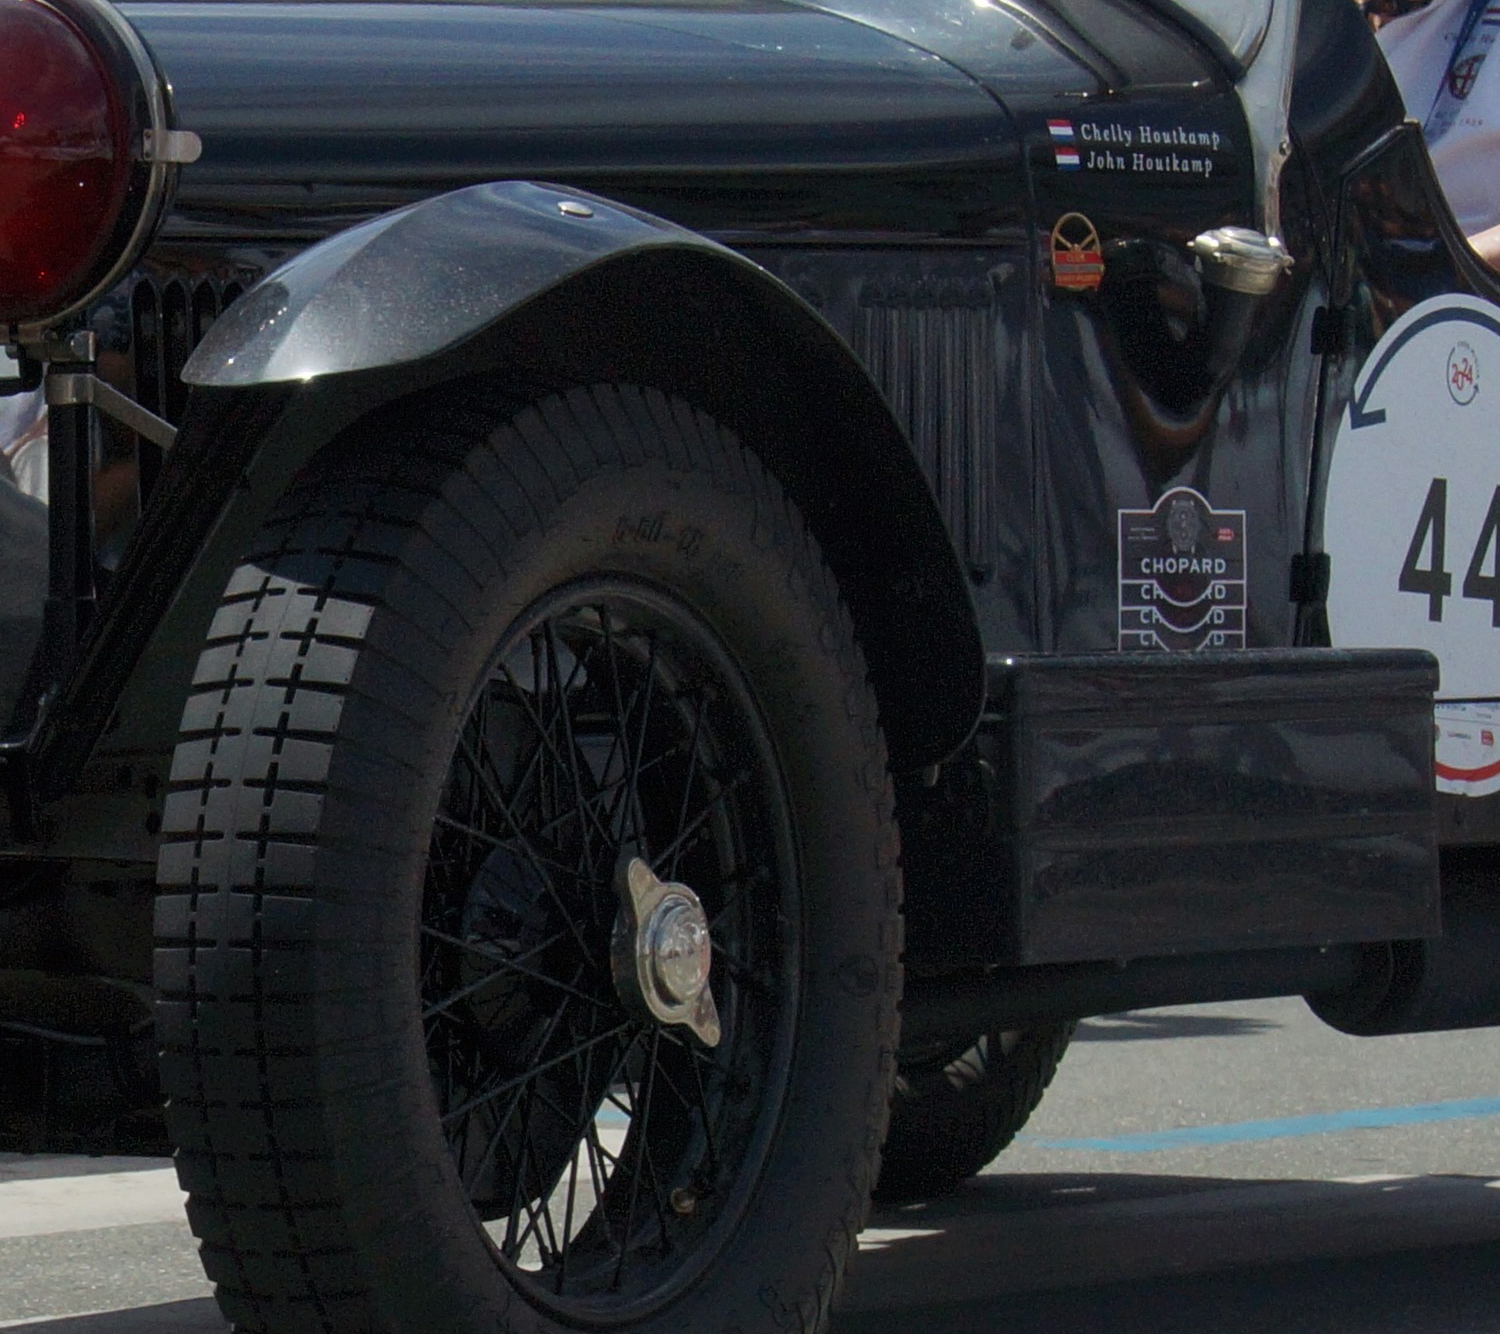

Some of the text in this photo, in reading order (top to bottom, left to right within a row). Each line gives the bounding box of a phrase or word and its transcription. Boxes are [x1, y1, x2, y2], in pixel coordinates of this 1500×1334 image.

[1080, 123, 1220, 151] Chelly Houtkamp
[1087, 151, 1213, 178] John Houtkamp
[1140, 557, 1226, 574] CHOPARD
[1140, 585, 1226, 599] CHRD
